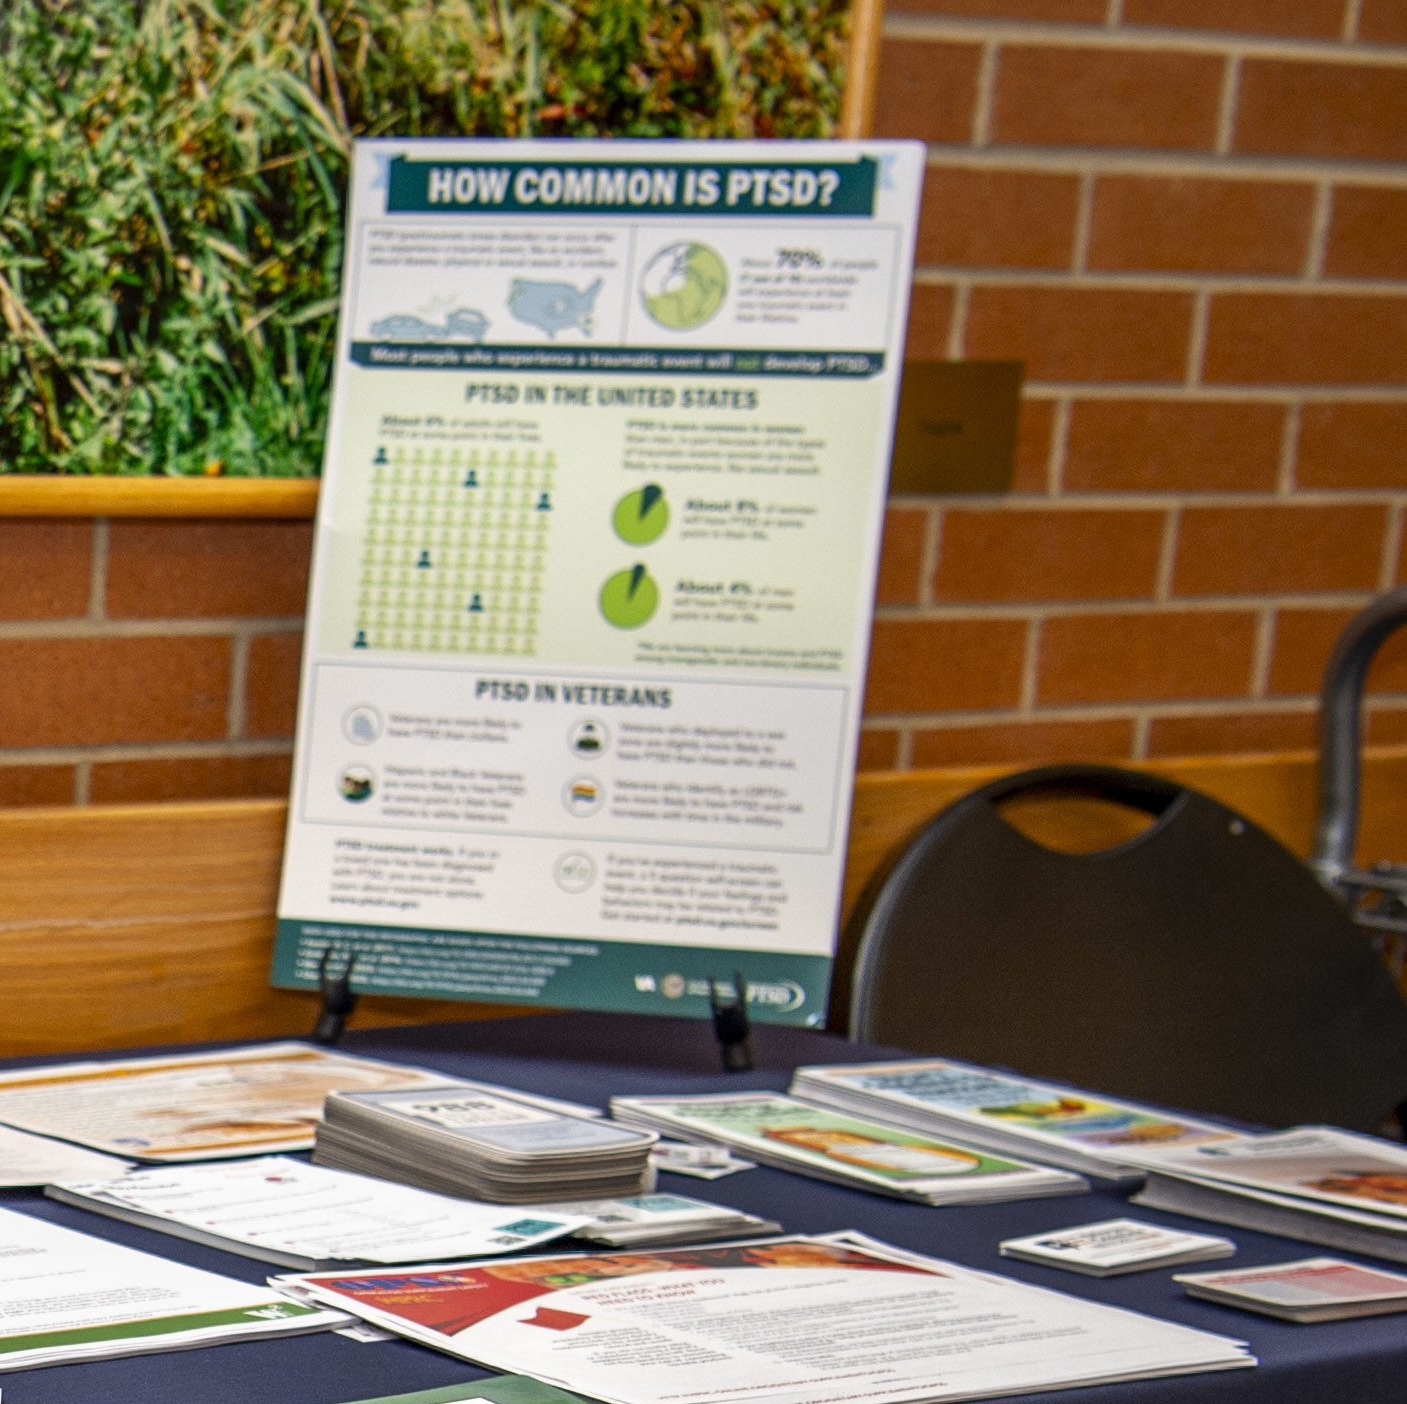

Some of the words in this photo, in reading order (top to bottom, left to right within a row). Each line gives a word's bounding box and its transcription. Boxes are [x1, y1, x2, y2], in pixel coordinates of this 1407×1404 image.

[428, 168, 507, 204] HOW
[514, 169, 680, 206] COMMON
[687, 170, 719, 205] IS
[727, 170, 840, 207] PTSD?
[464, 381, 521, 403] PTSD
[524, 383, 546, 403] IN
[553, 385, 593, 406] THE
[598, 386, 676, 408] UNITED
[681, 388, 760, 410] STATES
[474, 679, 529, 700] PTSD
[534, 683, 556, 701] IN
[562, 684, 673, 708] VETERANS
